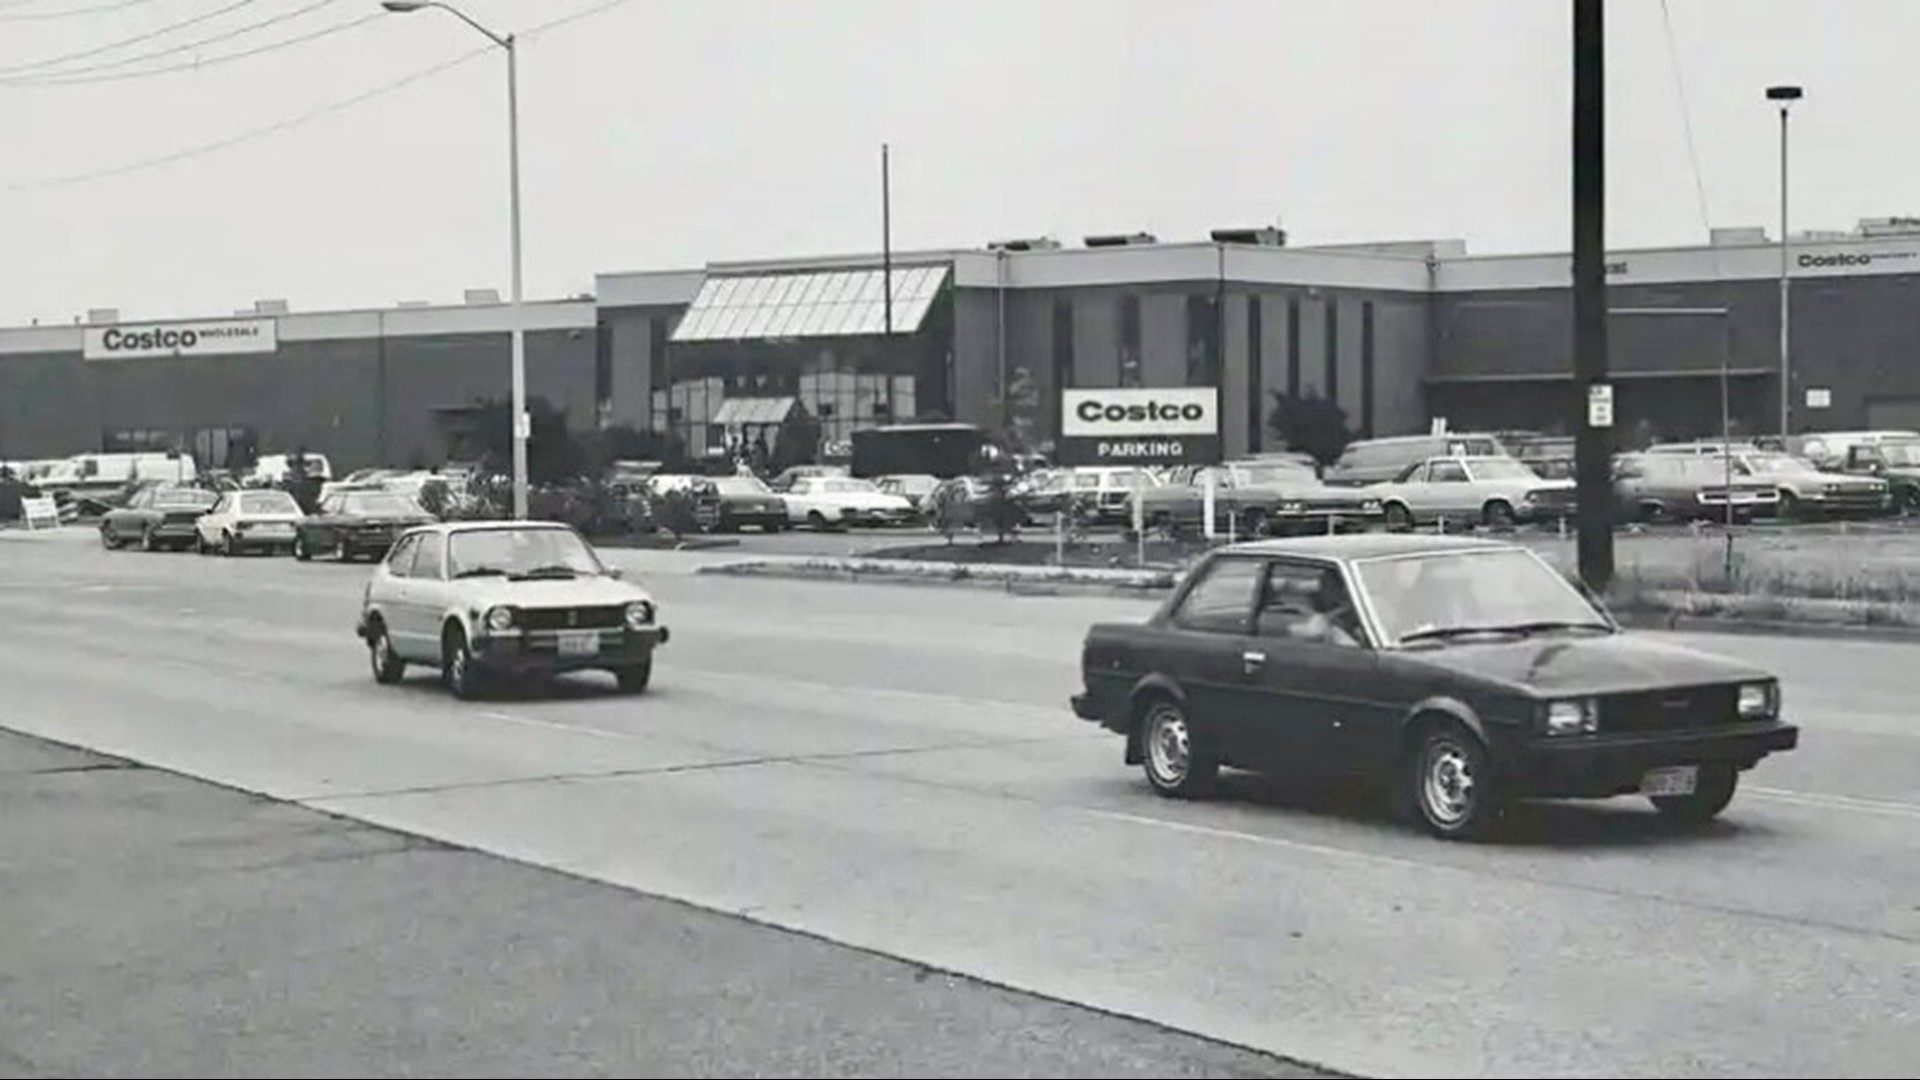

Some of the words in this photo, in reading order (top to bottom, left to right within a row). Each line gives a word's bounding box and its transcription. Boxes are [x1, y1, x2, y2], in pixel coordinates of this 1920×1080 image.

[1798, 253, 1871, 267] Costco
[103, 327, 197, 351] Costco
[199, 327, 259, 337] WHOLESALE
[1077, 399, 1203, 422] Costco
[1097, 441, 1183, 457] PARKING
